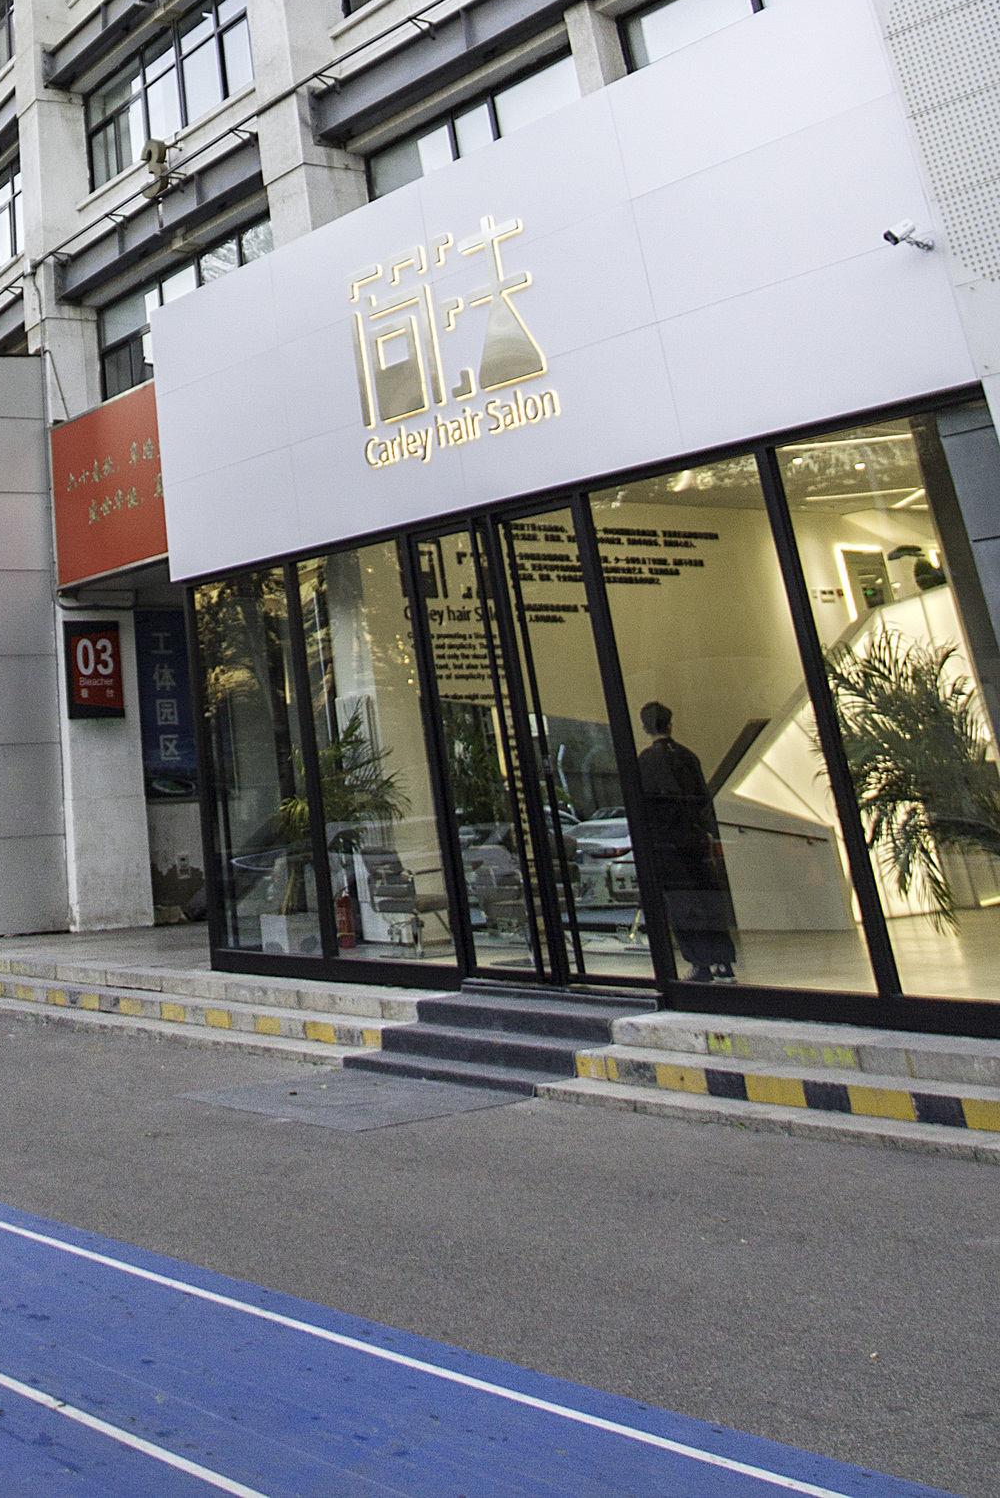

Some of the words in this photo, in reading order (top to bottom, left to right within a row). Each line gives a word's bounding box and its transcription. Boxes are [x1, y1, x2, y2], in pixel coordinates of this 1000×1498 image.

[365, 427, 433, 468] Carley
[435, 407, 484, 449] hair
[486, 388, 562, 436] Salon
[76, 638, 115, 676] 03
[79, 676, 114, 686] Bleacher
[151, 632, 181, 761] 工体园区
